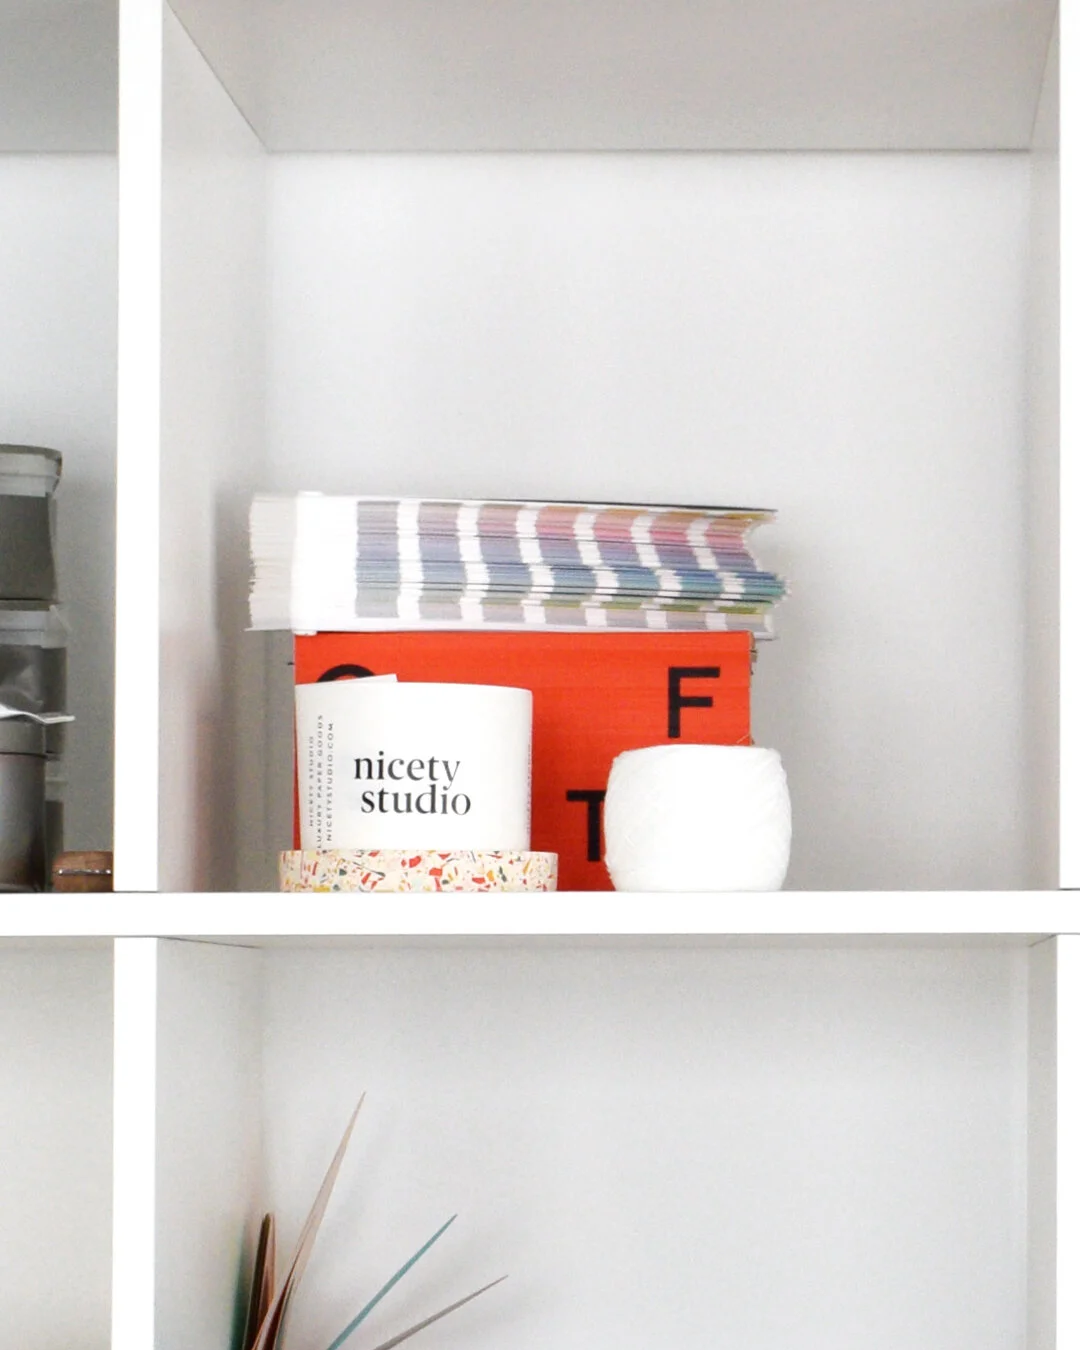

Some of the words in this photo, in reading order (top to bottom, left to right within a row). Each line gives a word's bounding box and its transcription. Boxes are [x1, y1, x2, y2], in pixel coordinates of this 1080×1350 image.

[668, 666, 720, 738] F
[354, 750, 460, 790] nicety
[360, 784, 471, 816] studio
